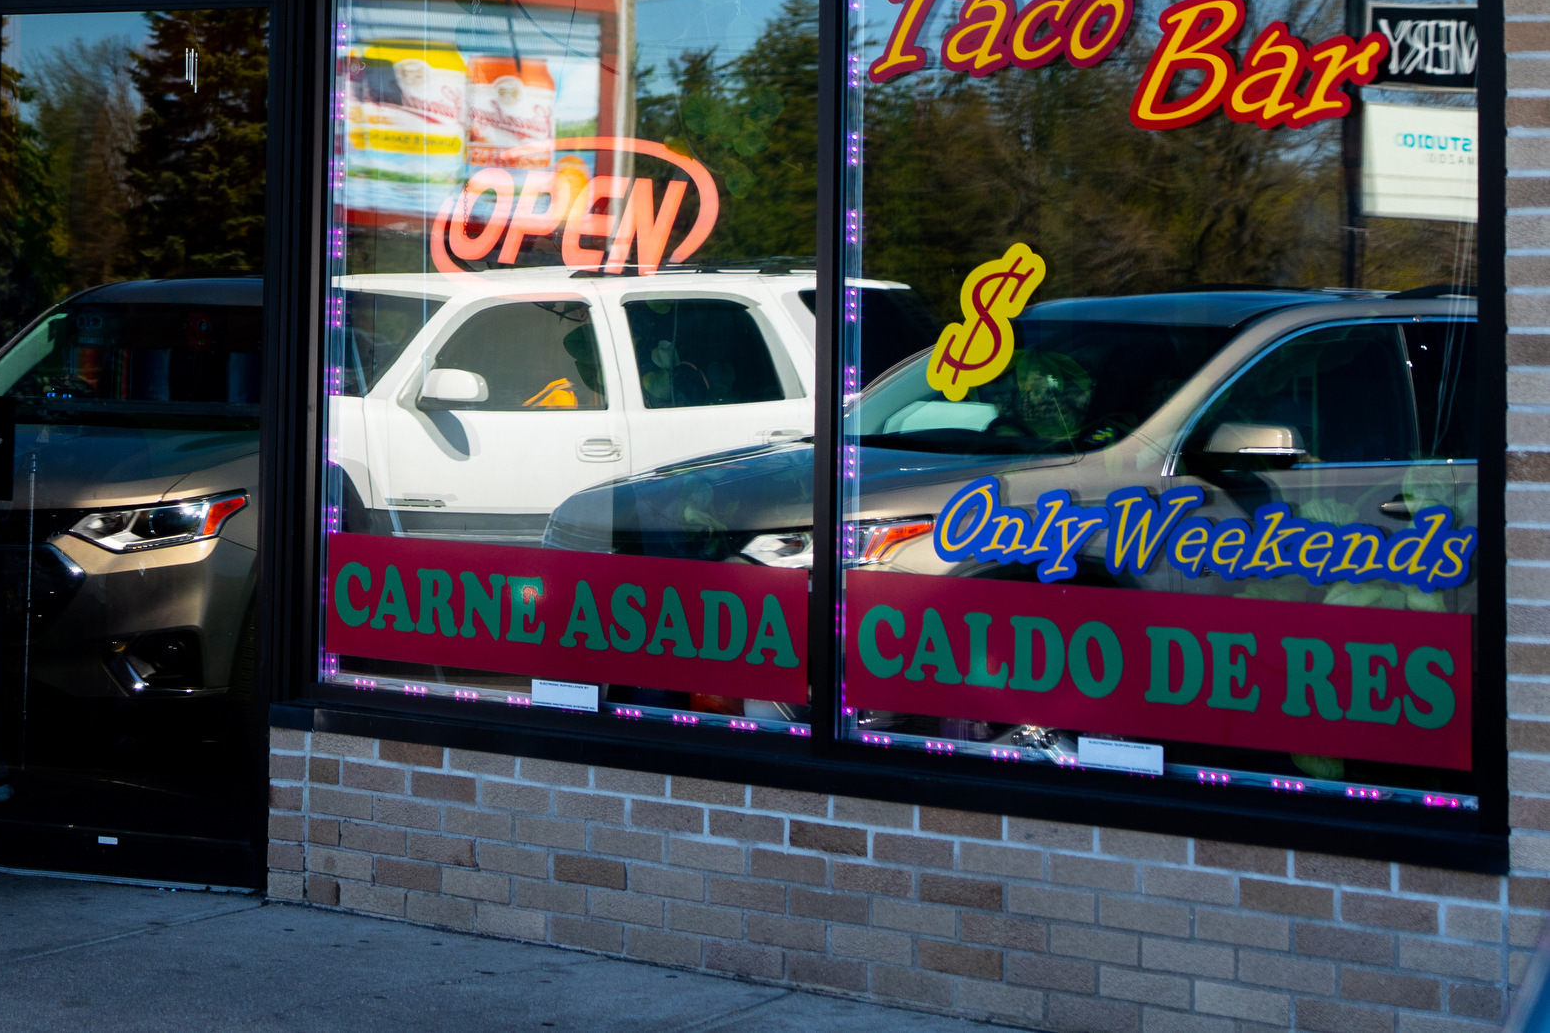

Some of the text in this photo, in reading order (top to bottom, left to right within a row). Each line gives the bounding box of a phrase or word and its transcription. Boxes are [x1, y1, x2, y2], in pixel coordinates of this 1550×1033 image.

[448, 167, 688, 276] OPEN
[931, 248, 1041, 394] $
[935, 477, 1477, 591] Only Weekends
[334, 561, 800, 668] CARNE ASADA
[857, 604, 1456, 730] CALDO DE RES
